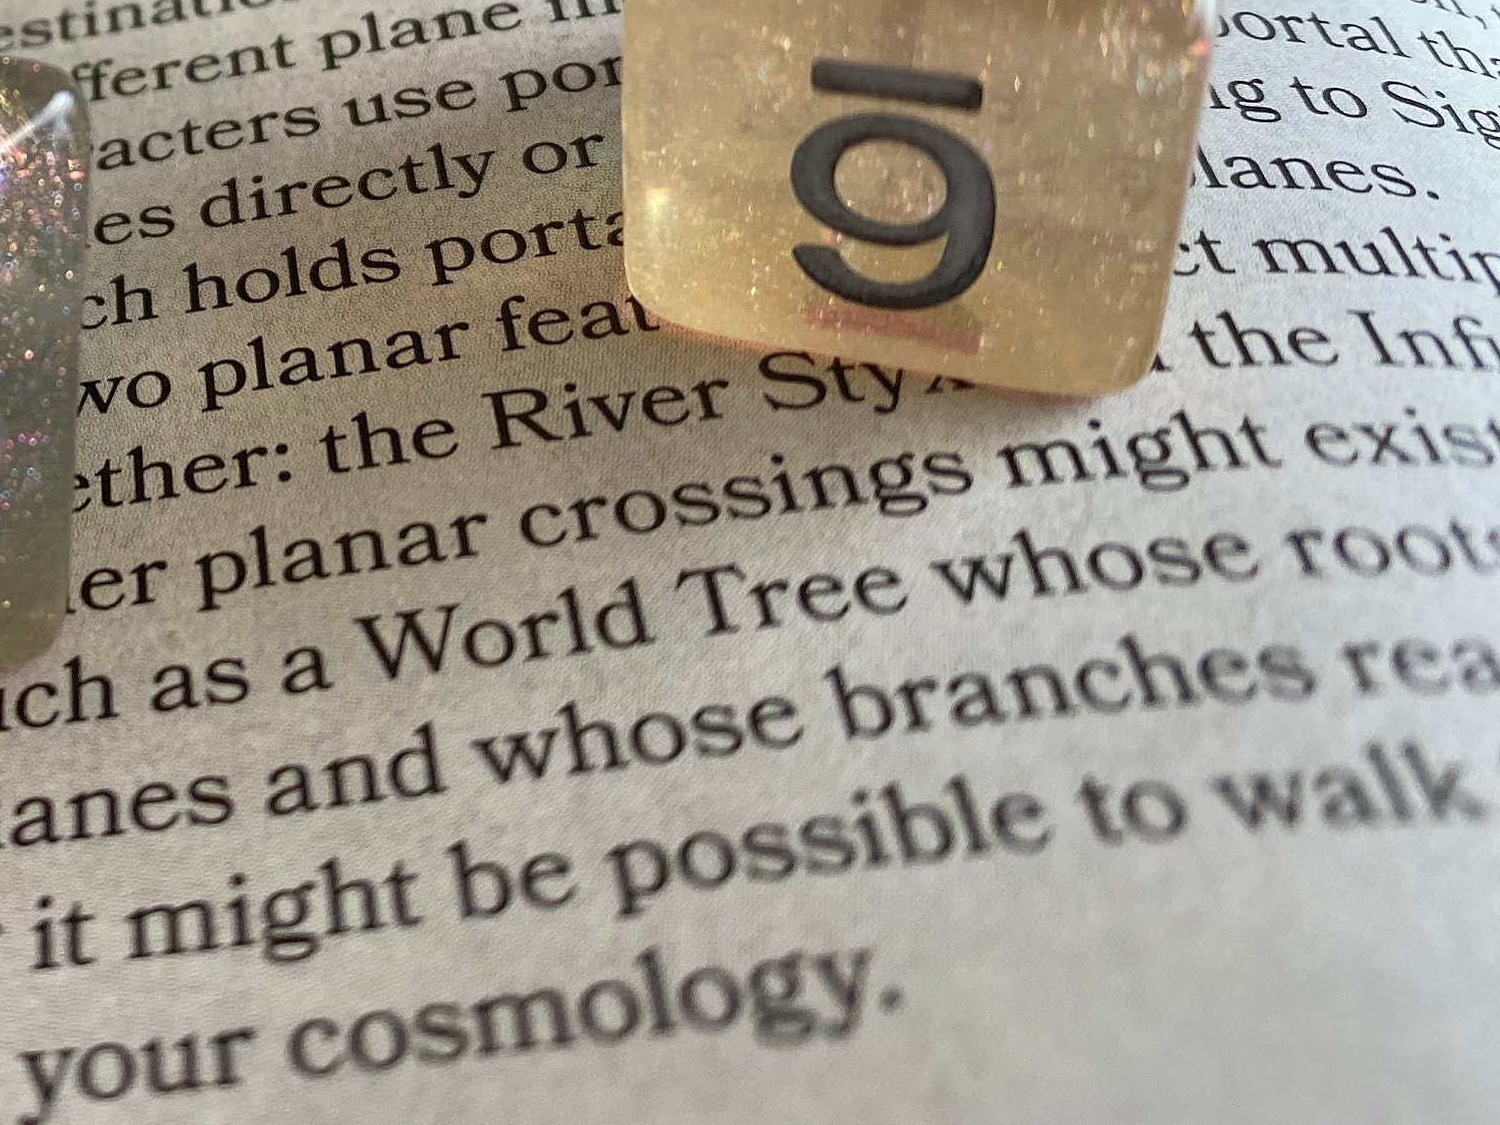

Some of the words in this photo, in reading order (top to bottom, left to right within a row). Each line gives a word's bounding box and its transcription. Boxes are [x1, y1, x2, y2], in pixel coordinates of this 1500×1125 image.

[96, 105, 321, 171] acters
[342, 78, 478, 127] use
[499, 55, 624, 113] por
[317, 0, 524, 72] plane
[1216, 10, 1412, 59] ortal
[80, 274, 160, 330] ch
[181, 236, 402, 314] holds
[424, 207, 624, 287] porta
[1190, 145, 1440, 201] lanes.
[90, 204, 176, 246] es
[200, 141, 496, 228] directly
[522, 133, 605, 176] or
[1289, 76, 1369, 119] to
[1381, 80, 1500, 152] Sig
[76, 370, 173, 419] wo
[197, 321, 470, 413] planar
[495, 294, 661, 353] feat
[1251, 226, 1500, 298] multip
[318, 410, 460, 474] the
[480, 375, 730, 450] River
[1188, 311, 1340, 370] the
[1346, 309, 1500, 372] Infi
[66, 559, 169, 613] er
[194, 512, 491, 614] planar
[519, 448, 975, 549] crossings
[996, 408, 1284, 495] might
[150, 655, 250, 716] as
[282, 644, 334, 696] a
[355, 579, 658, 682] World
[675, 562, 910, 638] Tree
[931, 527, 1262, 606] whose
[266, 722, 449, 818] and
[472, 690, 806, 786] whose
[826, 632, 1319, 744] branches
[1339, 638, 1500, 699] rea
[30, 893, 97, 971] it
[125, 855, 423, 965] might
[448, 837, 577, 921] be
[606, 771, 1054, 919] possible
[1077, 772, 1190, 848] to
[1211, 737, 1490, 835] walk
[16, 1026, 258, 1125] your
[286, 944, 907, 1078] cosmology.
